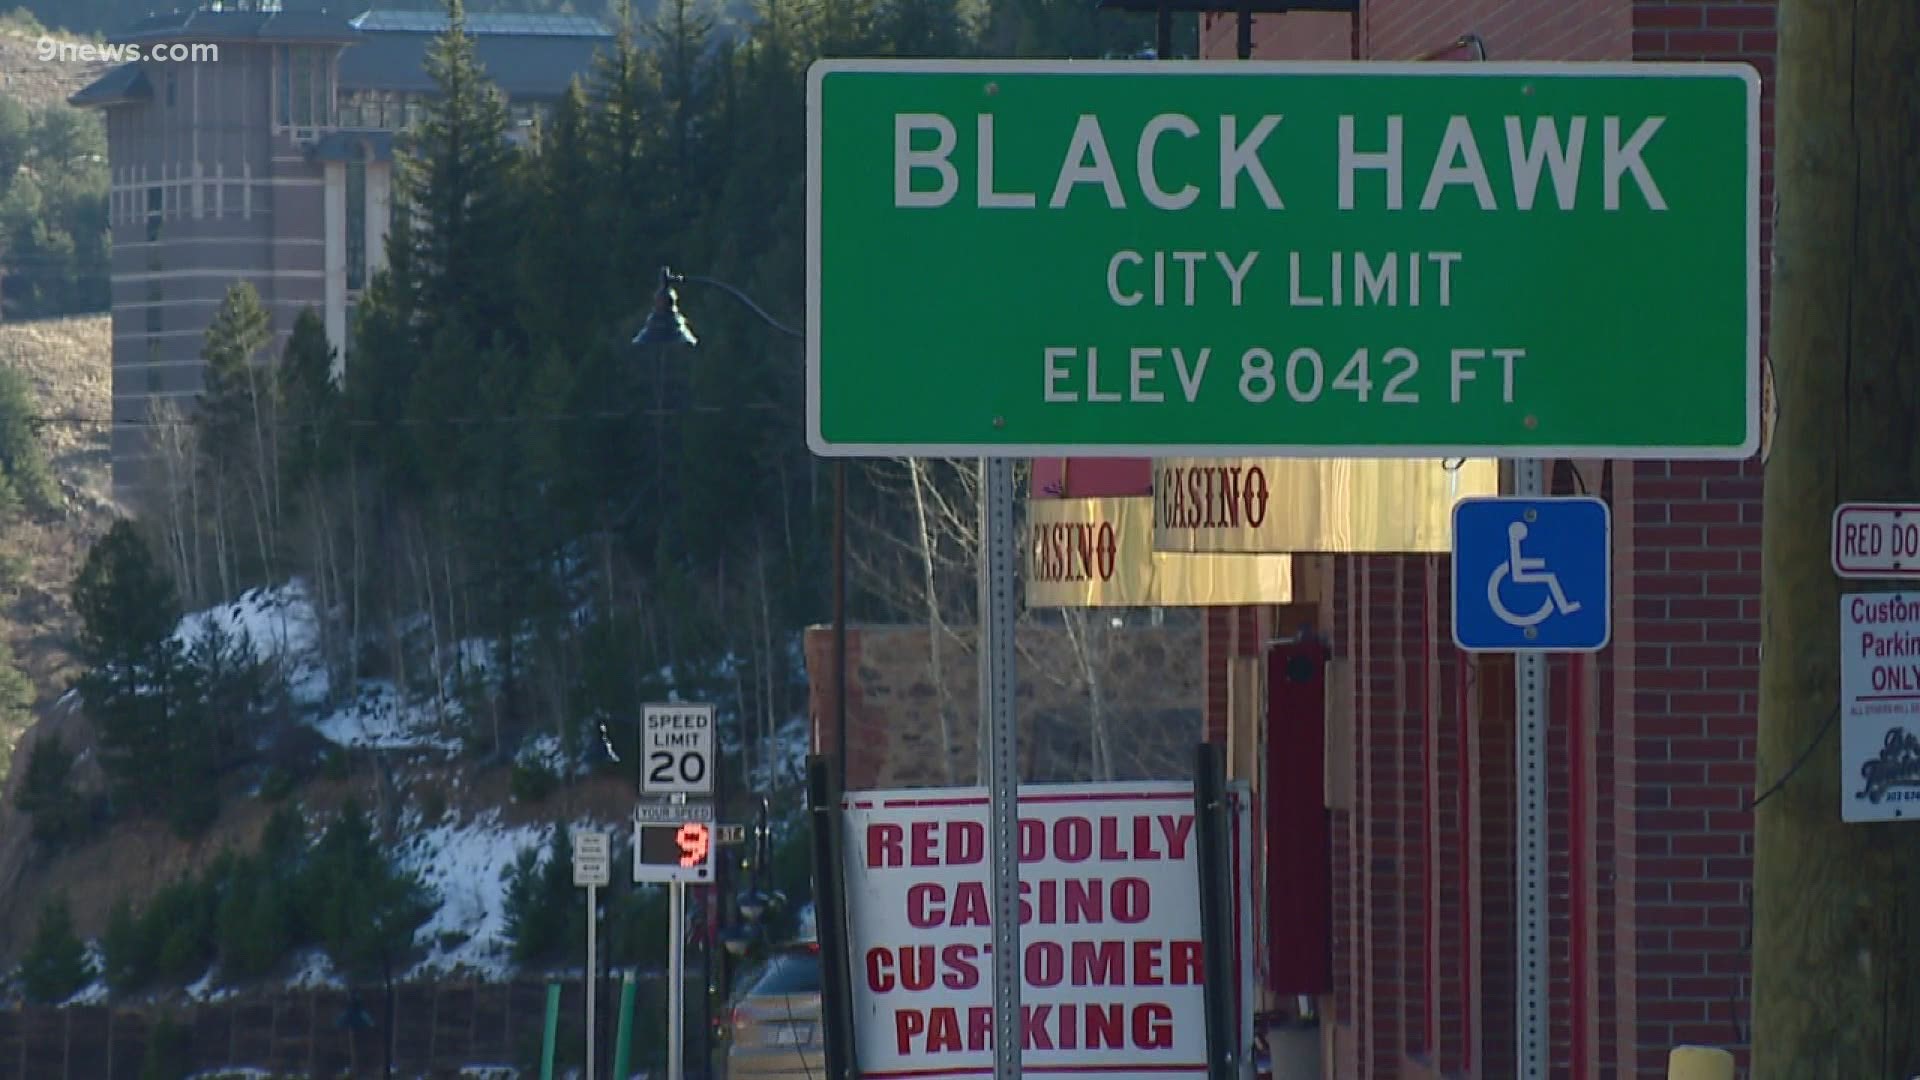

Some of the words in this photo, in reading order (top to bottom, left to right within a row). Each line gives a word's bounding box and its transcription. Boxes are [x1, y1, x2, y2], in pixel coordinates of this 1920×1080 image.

[893, 113, 1285, 210] BLACK
[1338, 114, 1668, 211] HAWK
[1107, 250, 1259, 307] CITY
[1289, 251, 1463, 307] LIMIT
[1043, 347, 1212, 403] ELEV
[1237, 347, 1421, 403] 8042
[1451, 348, 1527, 403] FT
[1163, 466, 1269, 529] CASINO
[1032, 521, 1116, 582] CASINO
[1845, 522, 1882, 557] RED
[648, 714, 708, 729] SPEED
[654, 732, 699, 747] LIMIT
[649, 751, 706, 783] 20
[676, 823, 708, 867] 9
[866, 821, 985, 869] RED
[1016, 815, 1196, 864] DOLLY
[865, 940, 1206, 993] CUSOMER
[895, 1002, 1174, 1055] PARKING
